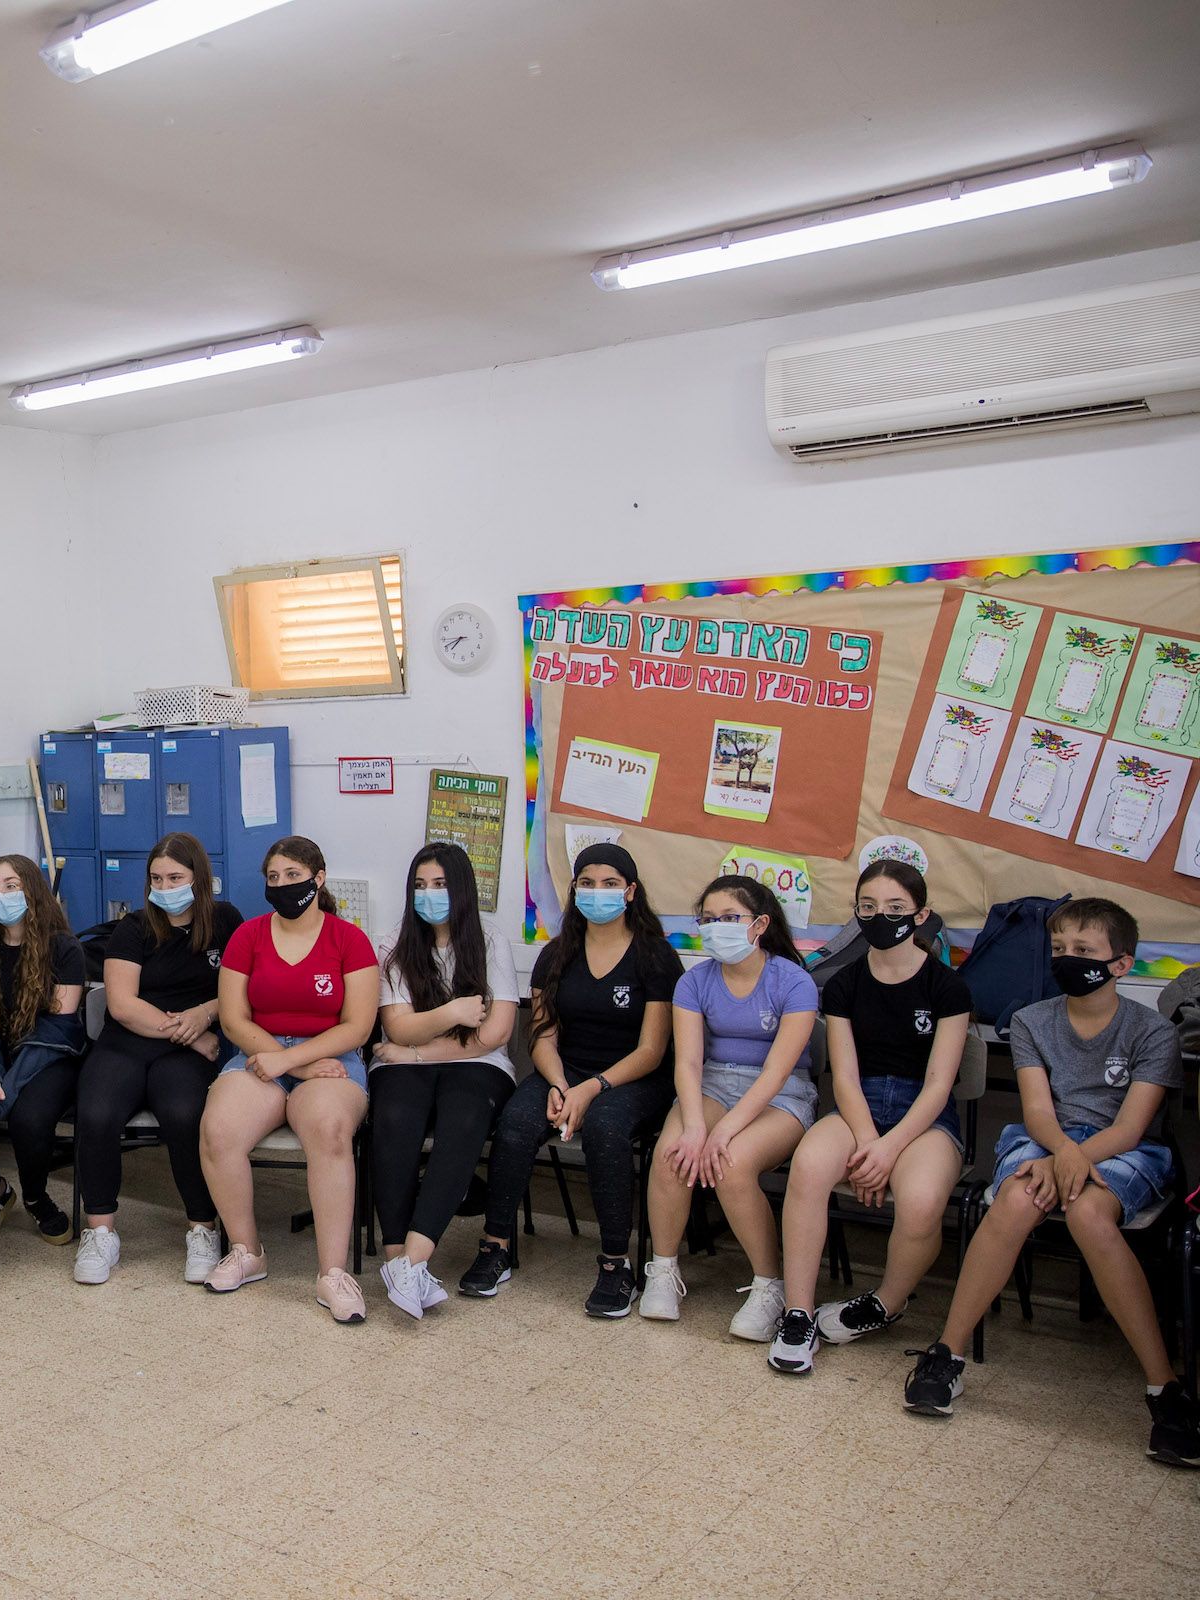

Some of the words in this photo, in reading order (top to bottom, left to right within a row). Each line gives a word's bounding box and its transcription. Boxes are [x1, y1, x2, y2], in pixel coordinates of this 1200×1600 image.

[533, 608, 632, 648] השדה
[640, 615, 690, 652] עץ
[696, 620, 809, 665] האדם
[830, 632, 872, 672] כי
[532, 652, 618, 687] למעלה
[629, 660, 692, 688] שואף
[698, 668, 746, 696] הוא
[756, 671, 812, 704] העץ
[816, 680, 870, 709] כמו
[348, 761, 370, 770] בעצמך
[372, 760, 390, 769] האמן
[572, 750, 612, 768] הנדיב
[618, 758, 646, 774] העץ
[438, 776, 469, 790] הכיתה
[474, 780, 496, 794] חוקי
